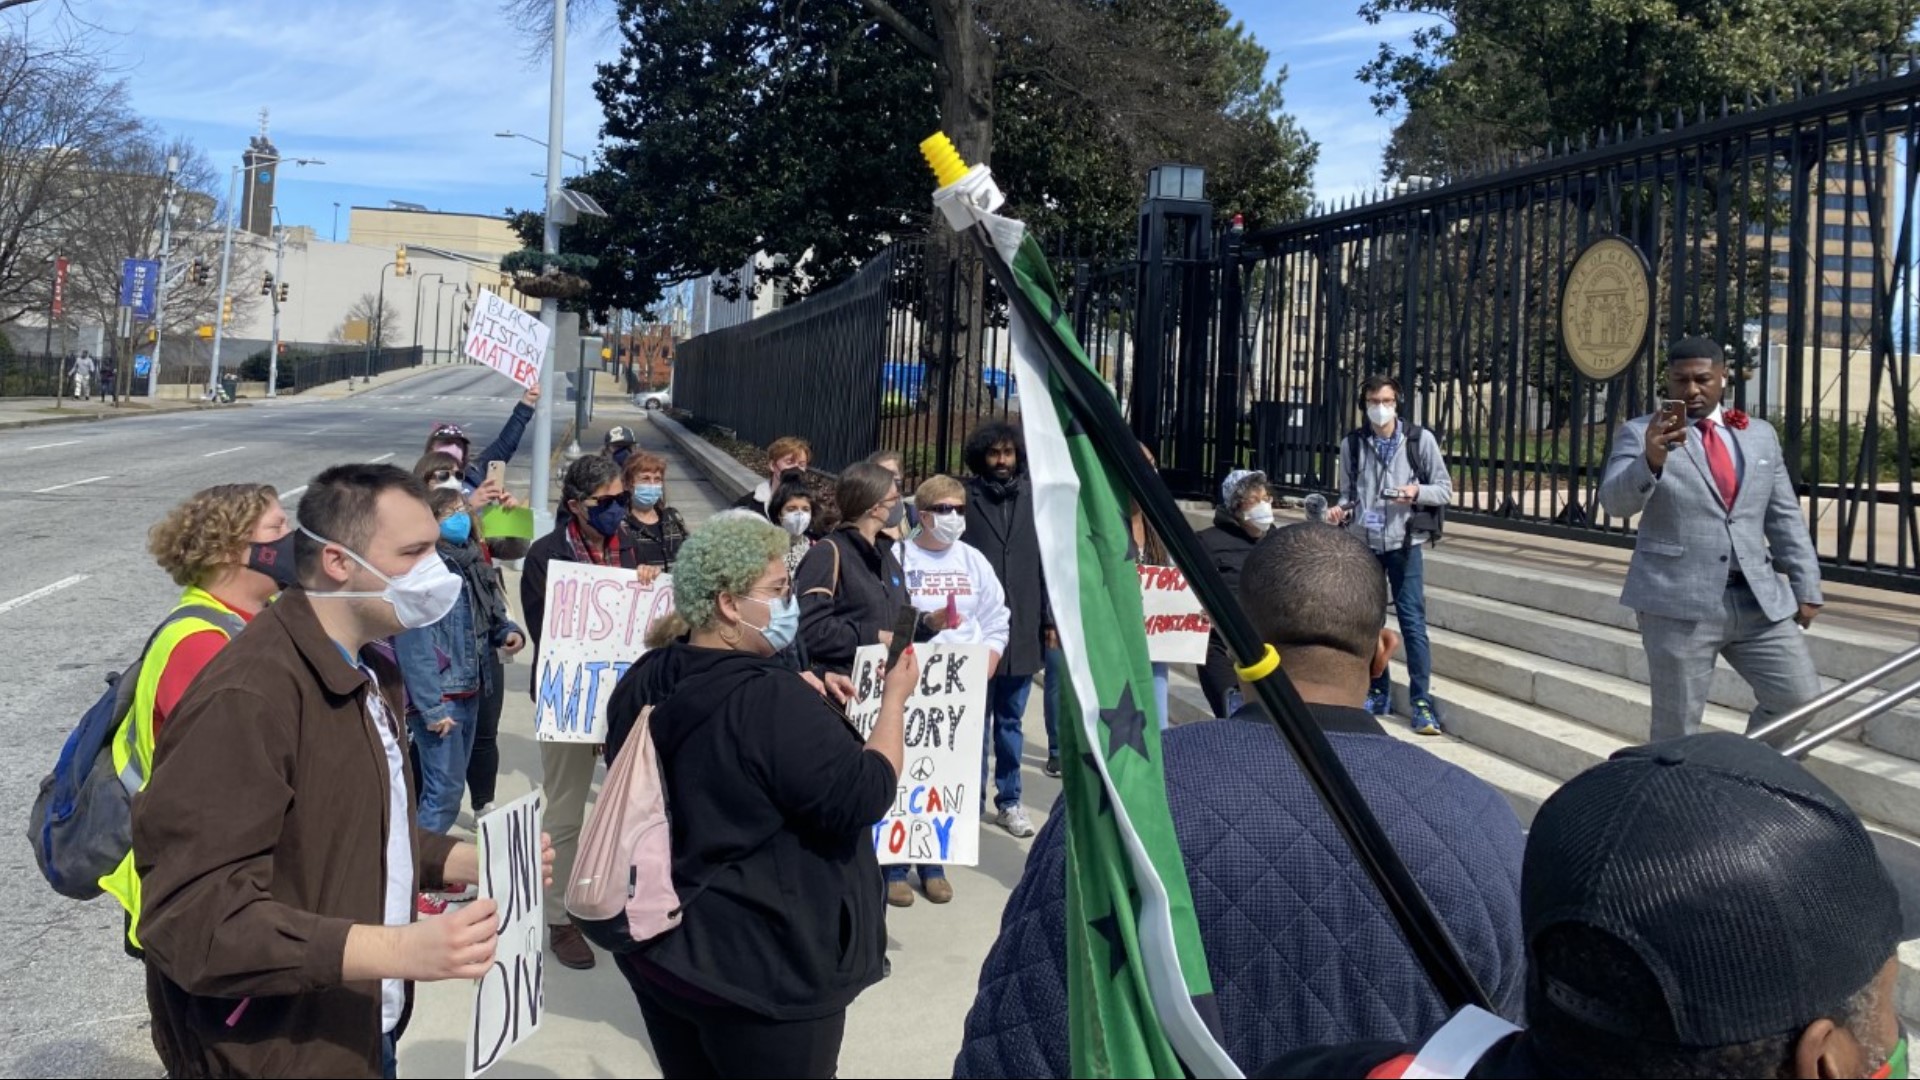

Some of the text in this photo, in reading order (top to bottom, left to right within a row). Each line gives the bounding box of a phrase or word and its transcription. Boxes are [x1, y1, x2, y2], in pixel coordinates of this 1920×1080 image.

[474, 311, 542, 364] HISTORY
[487, 295, 538, 342] BLACK
[907, 569, 971, 588] VOTE
[858, 653, 969, 703] BLCK
[473, 951, 543, 1073] DIV
